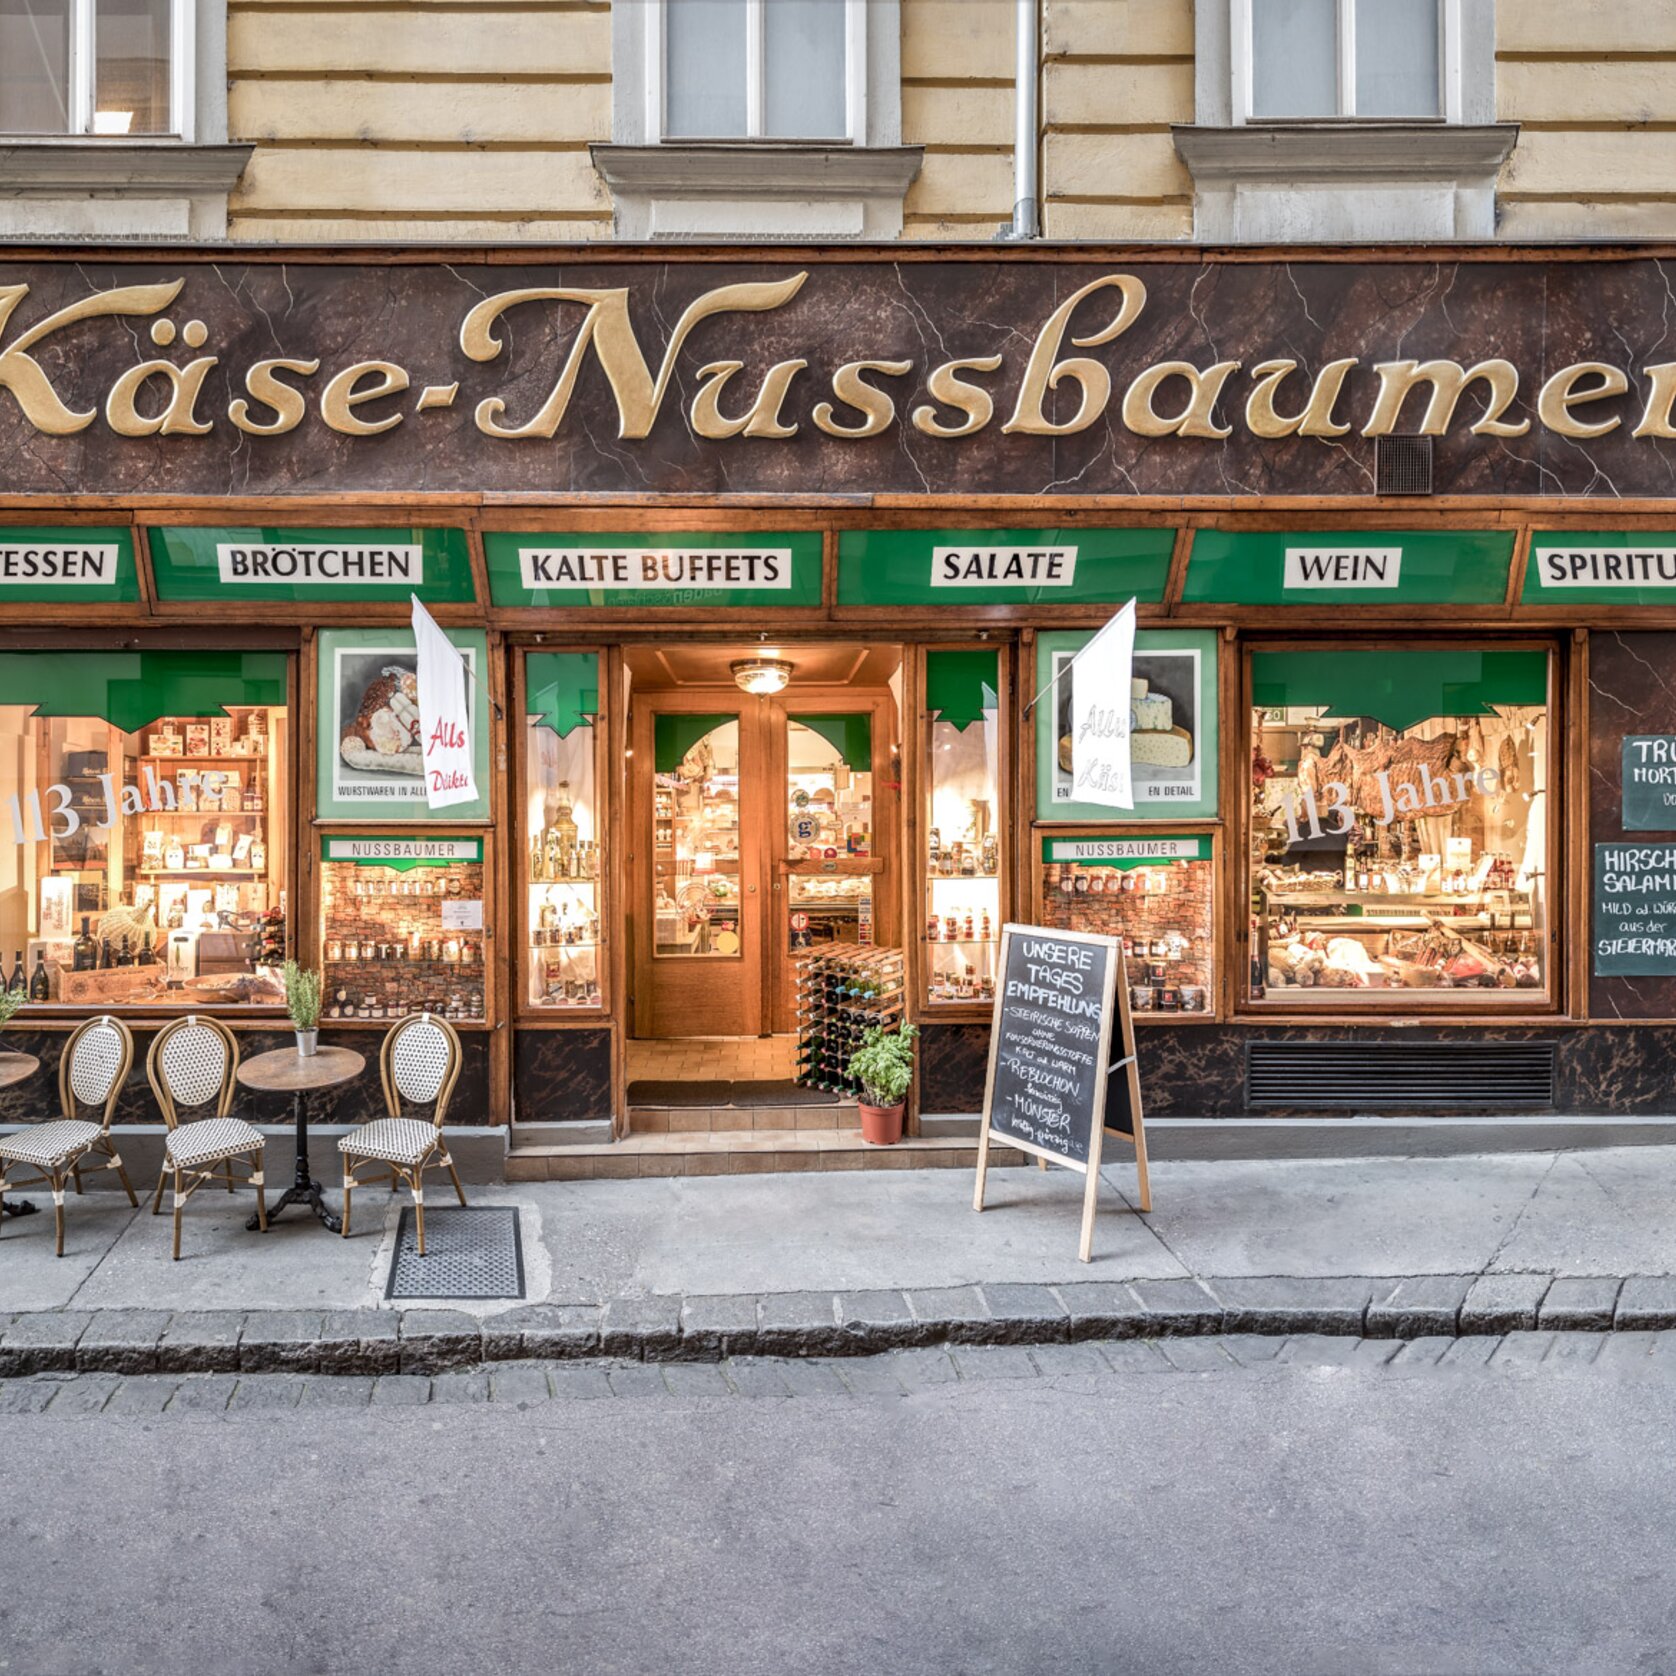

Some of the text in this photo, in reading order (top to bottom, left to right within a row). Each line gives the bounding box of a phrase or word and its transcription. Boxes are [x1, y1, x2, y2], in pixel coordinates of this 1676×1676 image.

[0, 550, 104, 577] ESSEN
[231, 546, 411, 578] BRÖTCHEN
[531, 553, 780, 582] KALTE BUFFETS
[942, 552, 1065, 581] SALATE
[1298, 554, 1388, 582] WEIN
[1547, 554, 1676, 580] SPIRITU
[6, 765, 226, 844] 113 Jahre
[338, 785, 395, 797] WURSTWAREN
[398, 785, 407, 796] IN
[1148, 785, 1195, 797] EN DETAIL
[1278, 763, 1501, 847] 113 Jahre
[352, 843, 455, 856] NUSSBAUMER
[1075, 842, 1178, 857] NUSSBAUMER
[1619, 919, 1668, 934] aus der
[1022, 940, 1094, 971] UNSERE
[1026, 963, 1084, 995] TAGES
[1006, 980, 1102, 1024] EMPFEHLUNG
